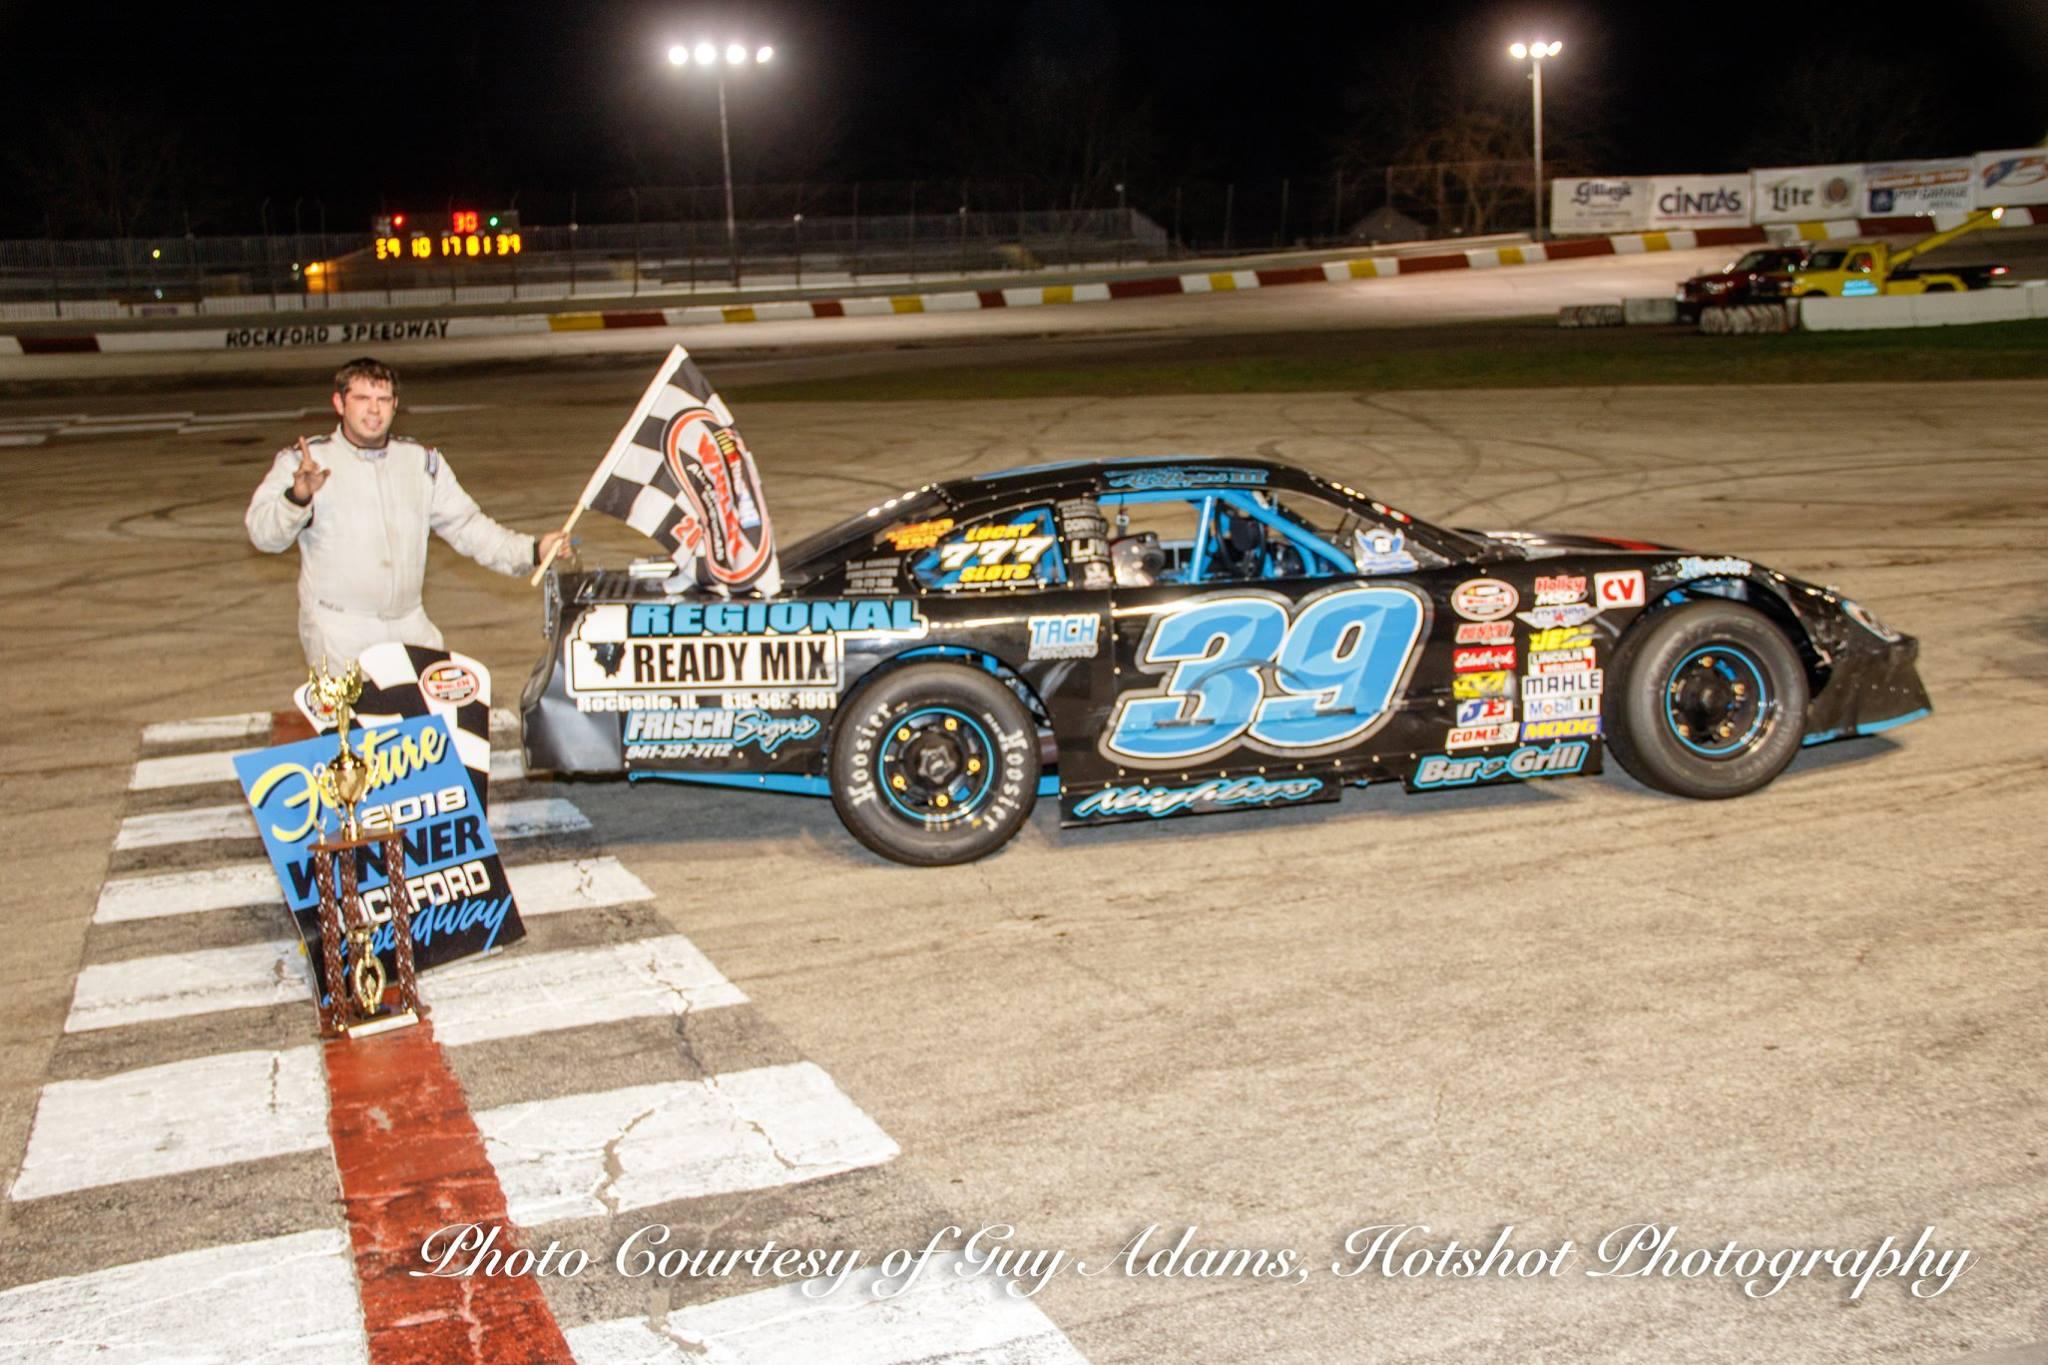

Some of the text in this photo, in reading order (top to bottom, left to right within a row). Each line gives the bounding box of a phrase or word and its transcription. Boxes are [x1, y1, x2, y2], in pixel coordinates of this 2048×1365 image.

[1770, 183, 1814, 212] Lite
[226, 319, 450, 348] ROCKFORD SPEEDWAY
[964, 523, 1037, 542] LUCKY
[939, 535, 1054, 571] 777
[958, 563, 1033, 583] SLOTS
[1602, 578, 1635, 602] CV
[629, 600, 924, 636] REGIONAL
[1033, 617, 1096, 645] TACH
[632, 640, 831, 684] READY MIX
[1106, 587, 1426, 760] 39
[1525, 672, 1600, 695] MAHLE
[1529, 699, 1574, 716] Mobil
[628, 710, 815, 747] FRISCH Signs
[1524, 718, 1598, 740] MOOG
[847, 702, 896, 807] Hoosier
[1419, 759, 1481, 785] Bar
[1510, 745, 1583, 775] Grill
[250, 726, 448, 843] Feture
[983, 729, 1029, 832] Hoosier
[360, 785, 469, 830] 2018
[286, 815, 487, 901] WNNER
